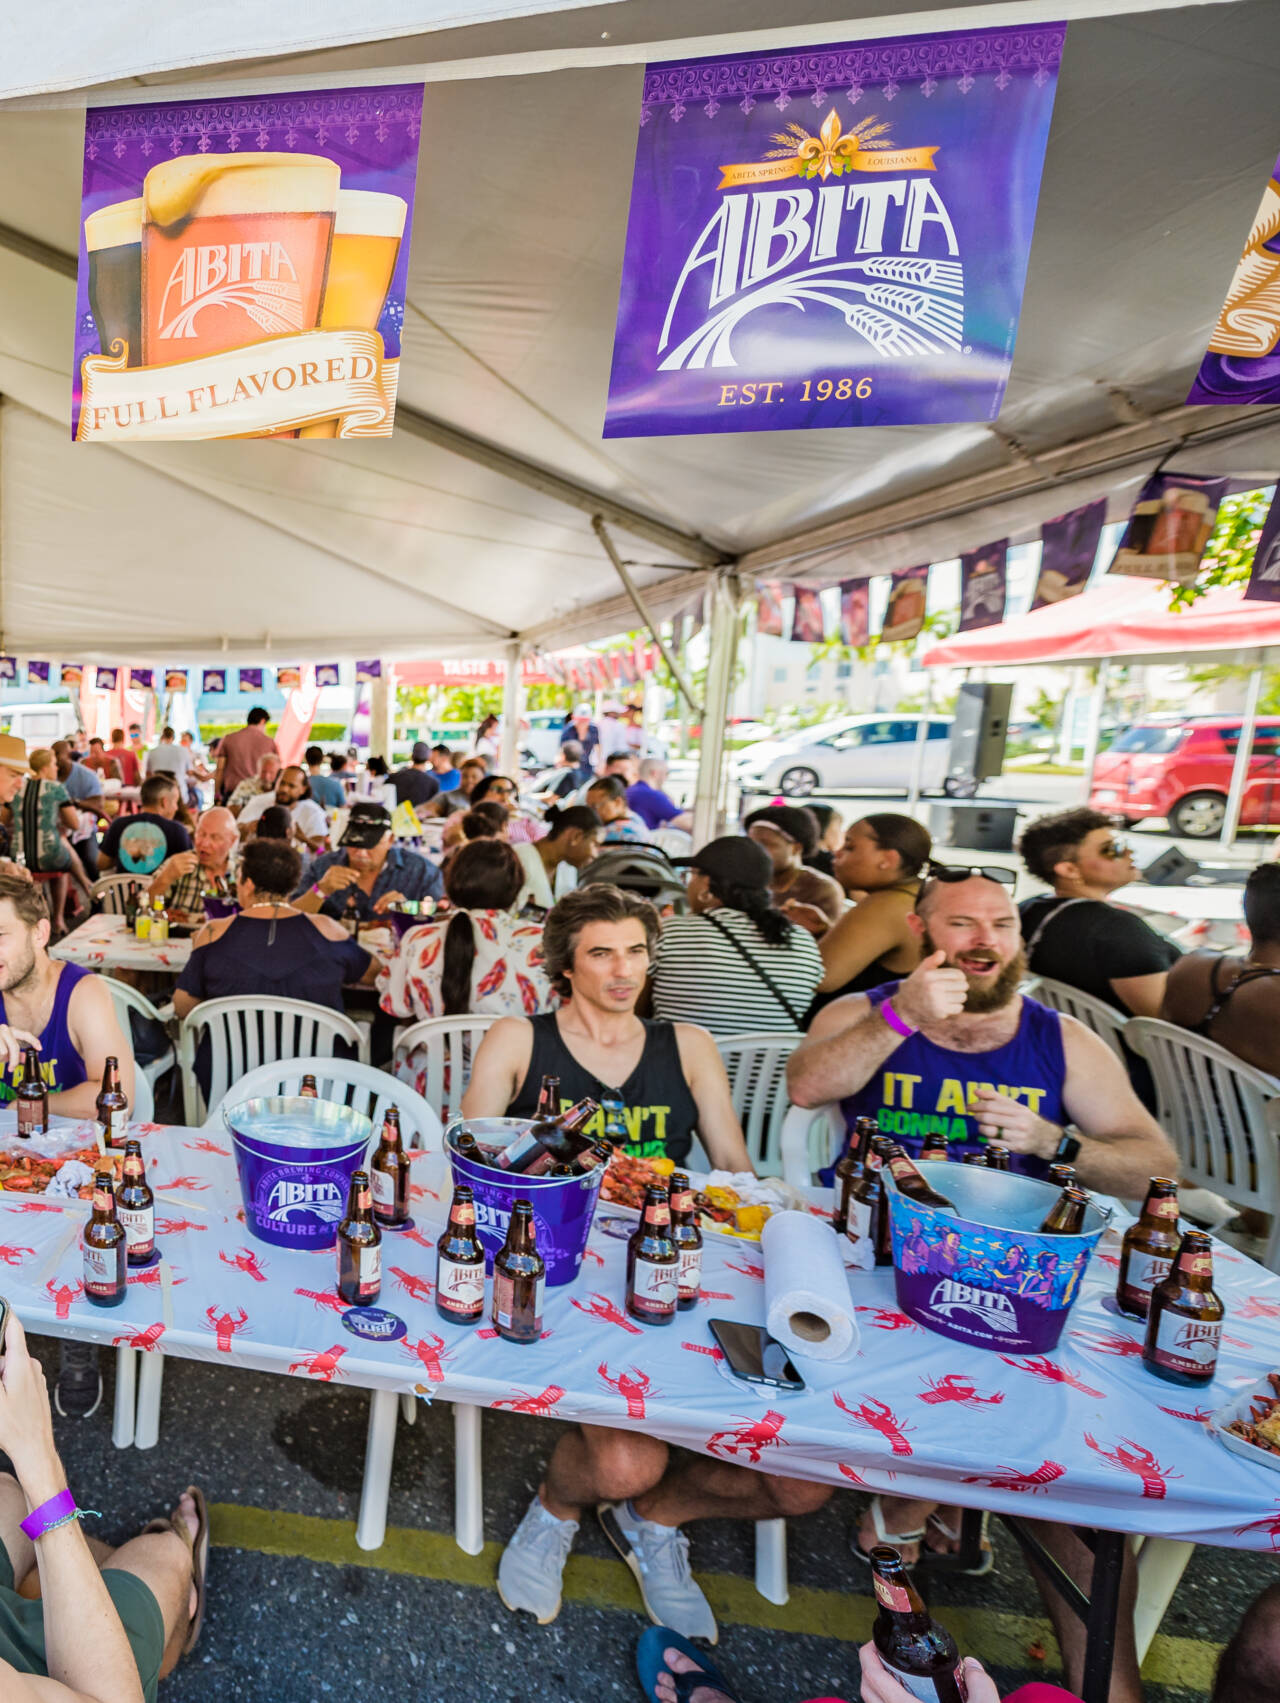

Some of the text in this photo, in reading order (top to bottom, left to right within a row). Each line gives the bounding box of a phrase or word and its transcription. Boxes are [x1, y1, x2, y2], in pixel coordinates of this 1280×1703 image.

[731, 165, 795, 180] ABITA SPRINGS
[867, 156, 918, 167] LOUISIANA
[657, 178, 959, 355] ABITA
[158, 242, 297, 330] ABITA
[92, 355, 374, 430] FULL FLAVORED
[718, 377, 873, 406] EST. 1986
[442, 660, 490, 676] TASTE
[883, 1072, 922, 1109] IT
[877, 1108, 968, 1142] GONNA
[278, 1165, 321, 1177] BREWING
[268, 1180, 342, 1207] ABITA
[256, 1215, 317, 1236] CULTURE
[473, 1200, 512, 1230] BIT
[929, 1278, 1015, 1313] ABITA
[1173, 1322, 1222, 1346] ABIT
[1171, 1357, 1203, 1370] AMBER
